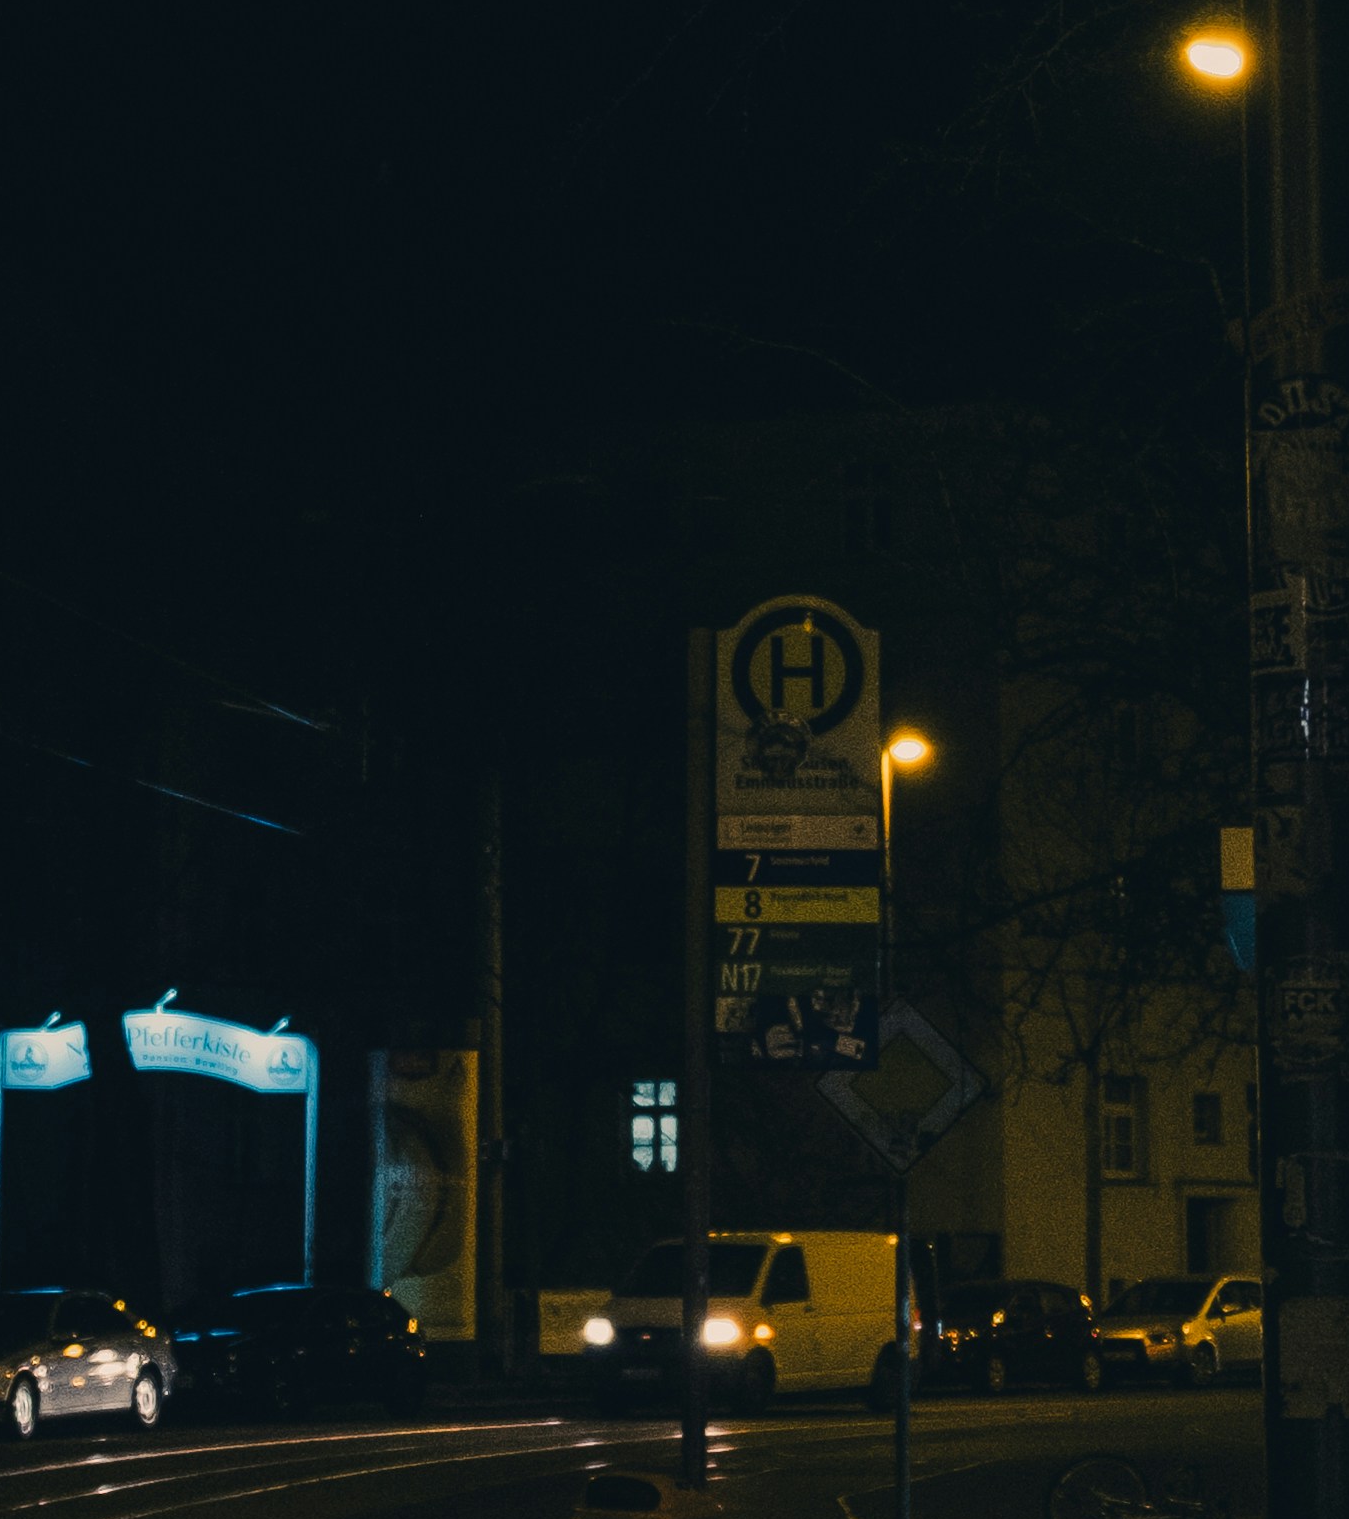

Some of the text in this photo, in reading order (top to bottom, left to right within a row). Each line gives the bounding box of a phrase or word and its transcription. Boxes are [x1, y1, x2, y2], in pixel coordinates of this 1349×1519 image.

[770, 636, 824, 708] H
[745, 854, 762, 883] 7
[745, 890, 762, 919] 8
[727, 927, 762, 956] 77
[720, 962, 763, 993] N17
[127, 1025, 252, 1065] Pfefferkiste
